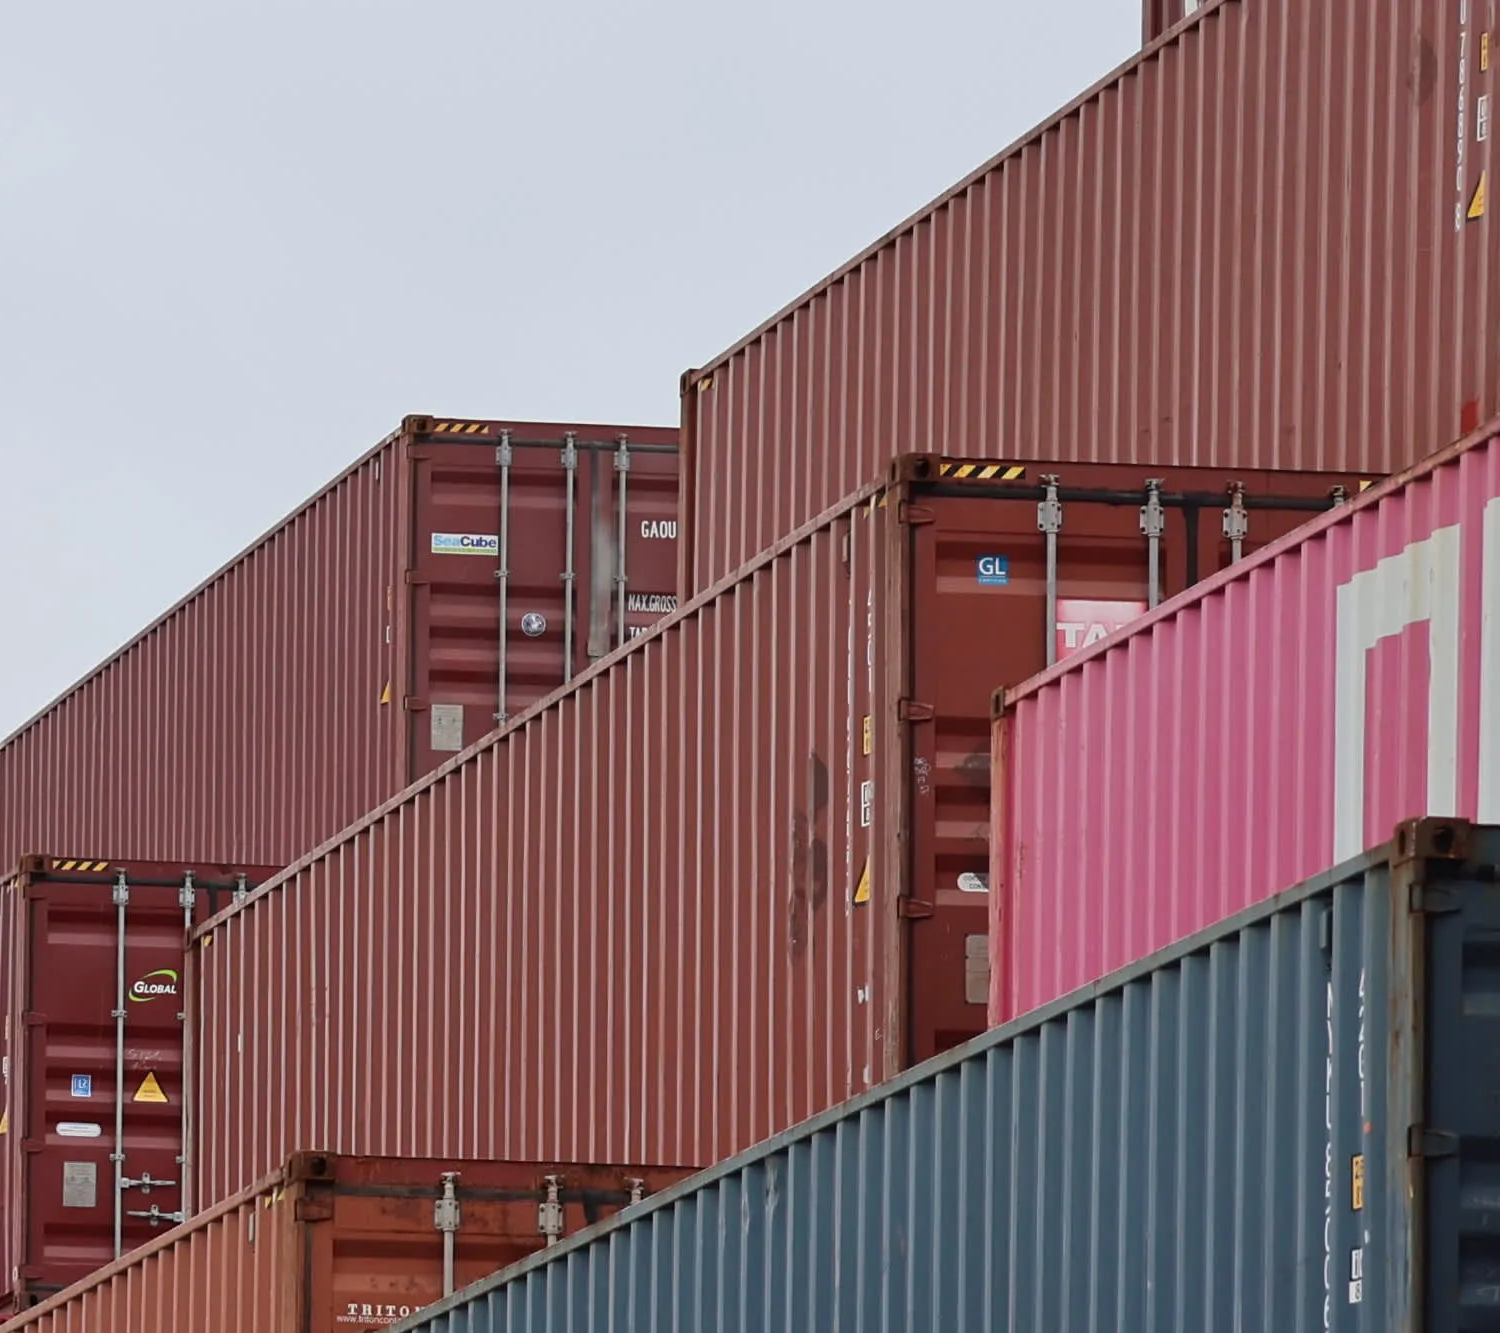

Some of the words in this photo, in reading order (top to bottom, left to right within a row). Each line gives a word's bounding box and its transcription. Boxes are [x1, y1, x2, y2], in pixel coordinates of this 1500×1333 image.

[641, 520, 677, 539] GAOU
[434, 535, 497, 549] SeaCube
[979, 558, 1005, 575] GL
[348, 1303, 426, 1317] TRITO
